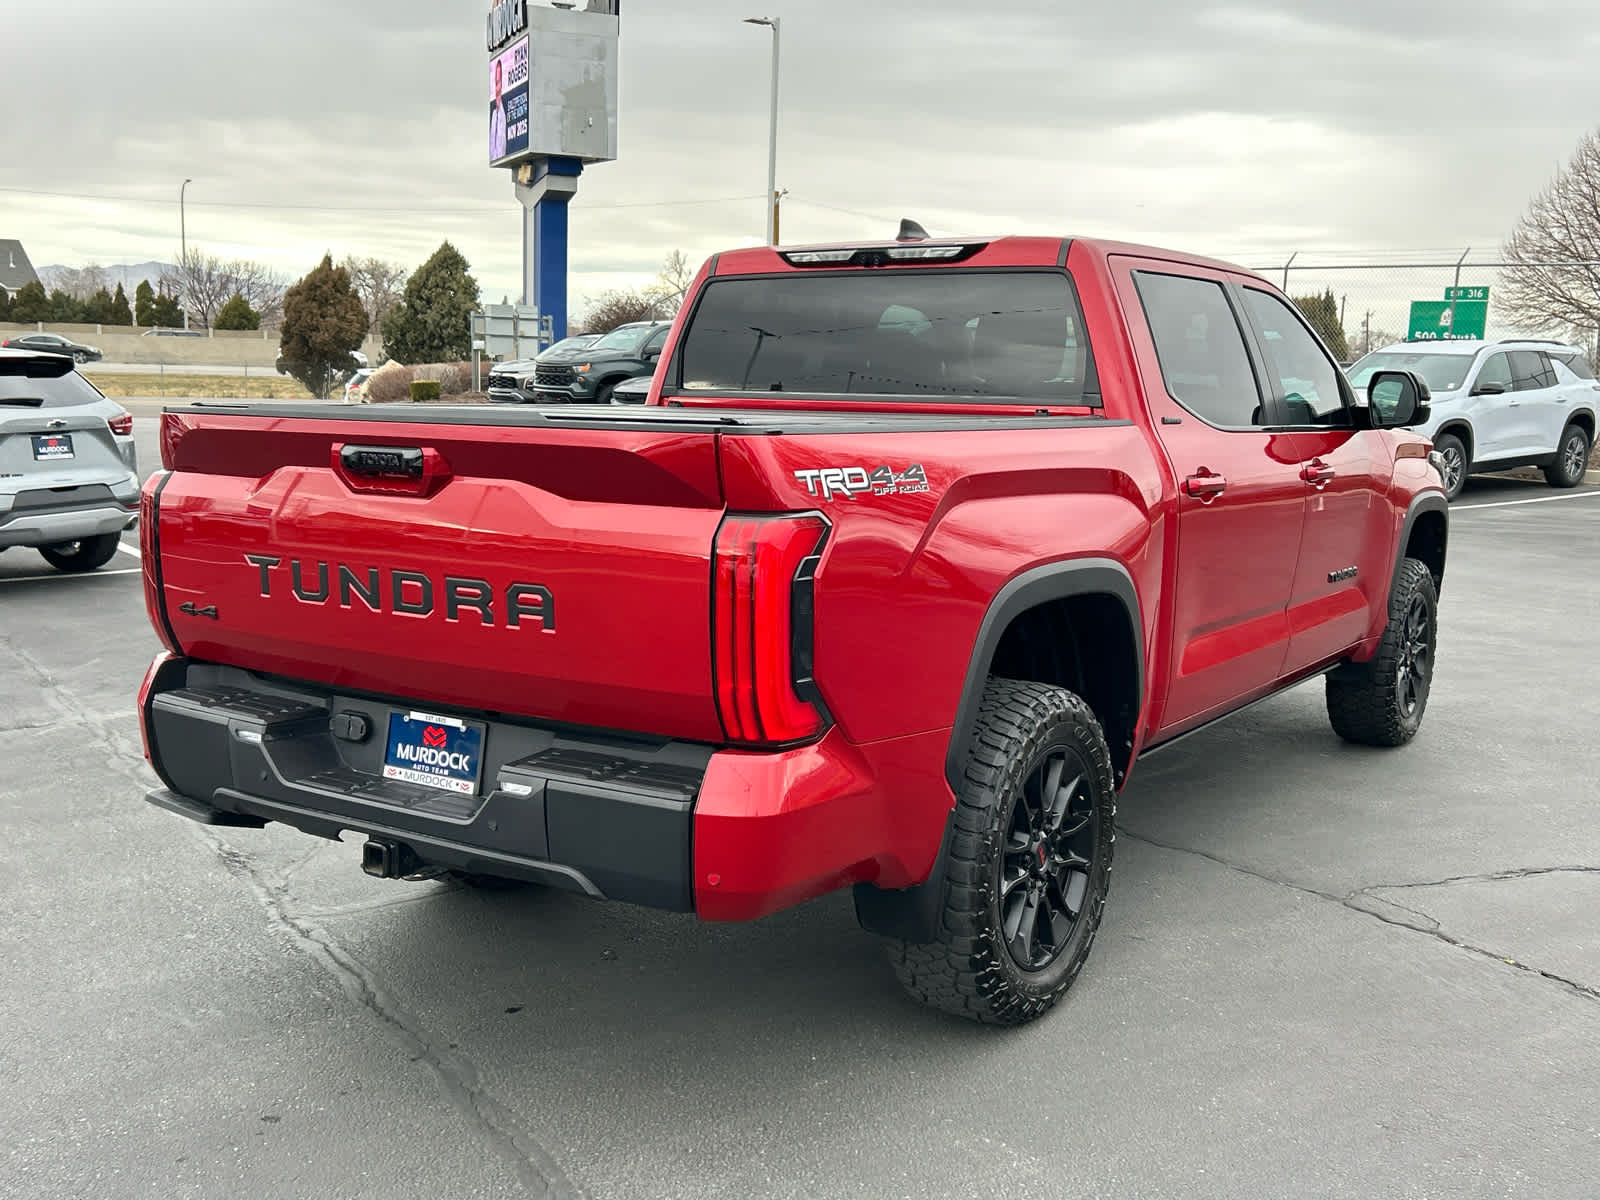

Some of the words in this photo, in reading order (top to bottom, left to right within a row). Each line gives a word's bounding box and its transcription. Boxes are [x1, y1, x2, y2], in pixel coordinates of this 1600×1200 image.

[507, 61, 528, 87] ROGERS
[1467, 289, 1483, 298] 316
[360, 452, 400, 466] TOYOTA
[244, 553, 556, 634] TUNDRA
[397, 743, 470, 771] MURDOCK
[412, 763, 430, 772] AUTO
[431, 766, 449, 776] TEAM
[403, 771, 453, 788] MURDOCK
